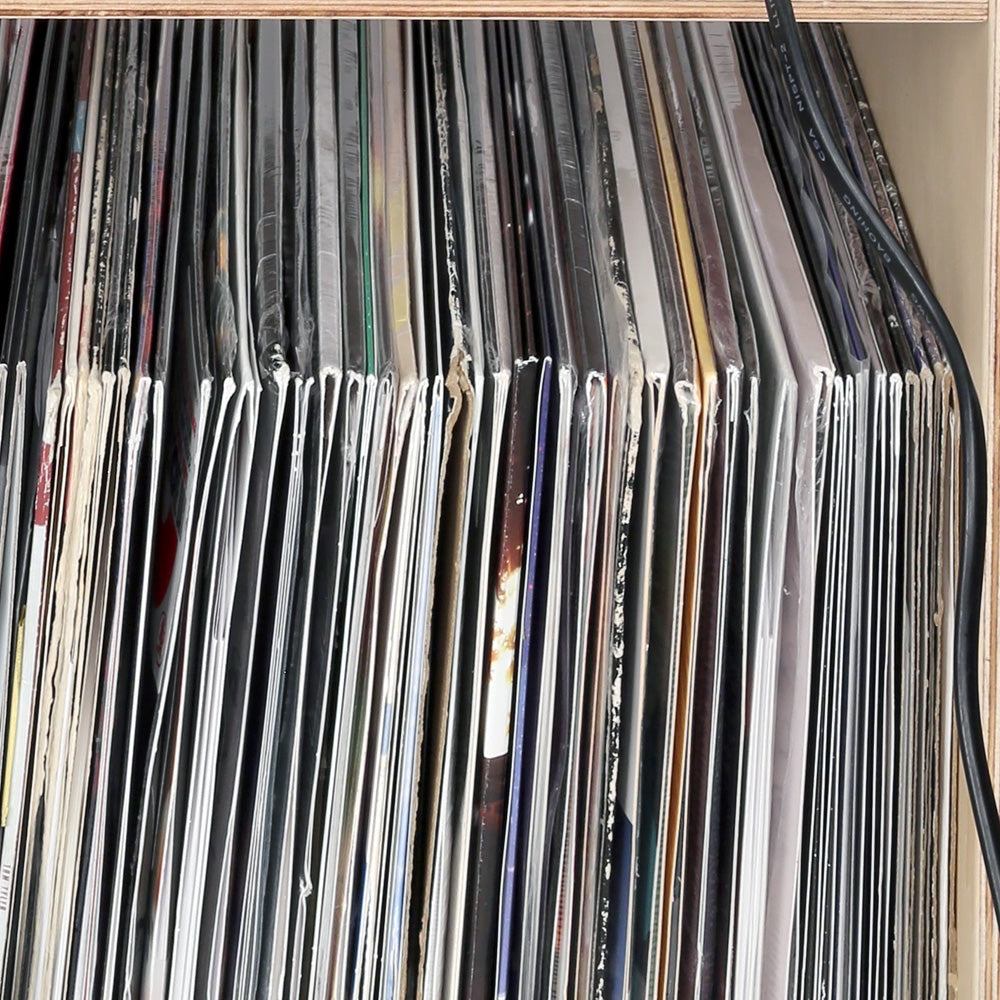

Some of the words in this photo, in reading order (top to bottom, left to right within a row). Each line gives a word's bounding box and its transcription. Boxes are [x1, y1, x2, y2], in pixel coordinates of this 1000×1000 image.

[777, 41, 805, 111] NISPT-2
[807, 127, 826, 162] CSA
[840, 192, 892, 263] BAOHING
